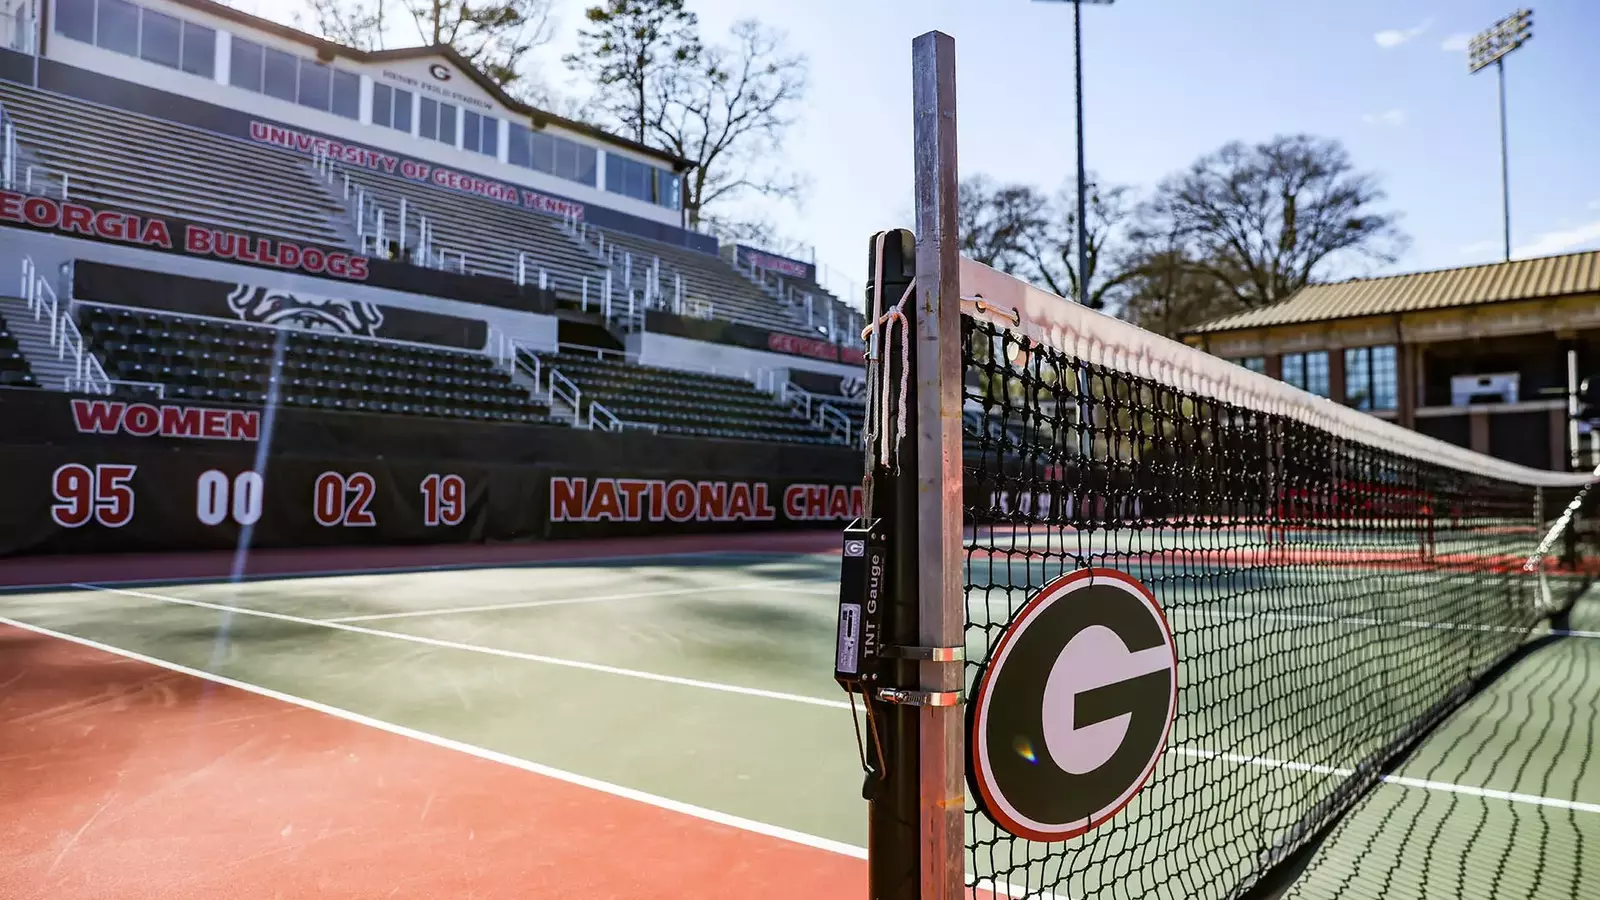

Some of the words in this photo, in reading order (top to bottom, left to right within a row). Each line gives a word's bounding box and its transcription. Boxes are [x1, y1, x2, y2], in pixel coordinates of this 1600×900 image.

[429, 63, 452, 81] G
[251, 120, 399, 174] UNIVERSITY
[400, 158, 429, 180] OF
[432, 167, 518, 204] GEORGIA
[522, 188, 584, 222] TENNIS
[185, 224, 369, 280] BULLDOGS
[71, 399, 260, 441] WOMEN
[51, 463, 137, 528] 95
[196, 470, 263, 526] 00
[314, 472, 376, 527] 02
[420, 474, 466, 526] 19
[551, 477, 775, 521] NATIONAL
[867, 554, 881, 614] Gauge
[864, 620, 876, 658] TNT
[986, 584, 1171, 825] G
